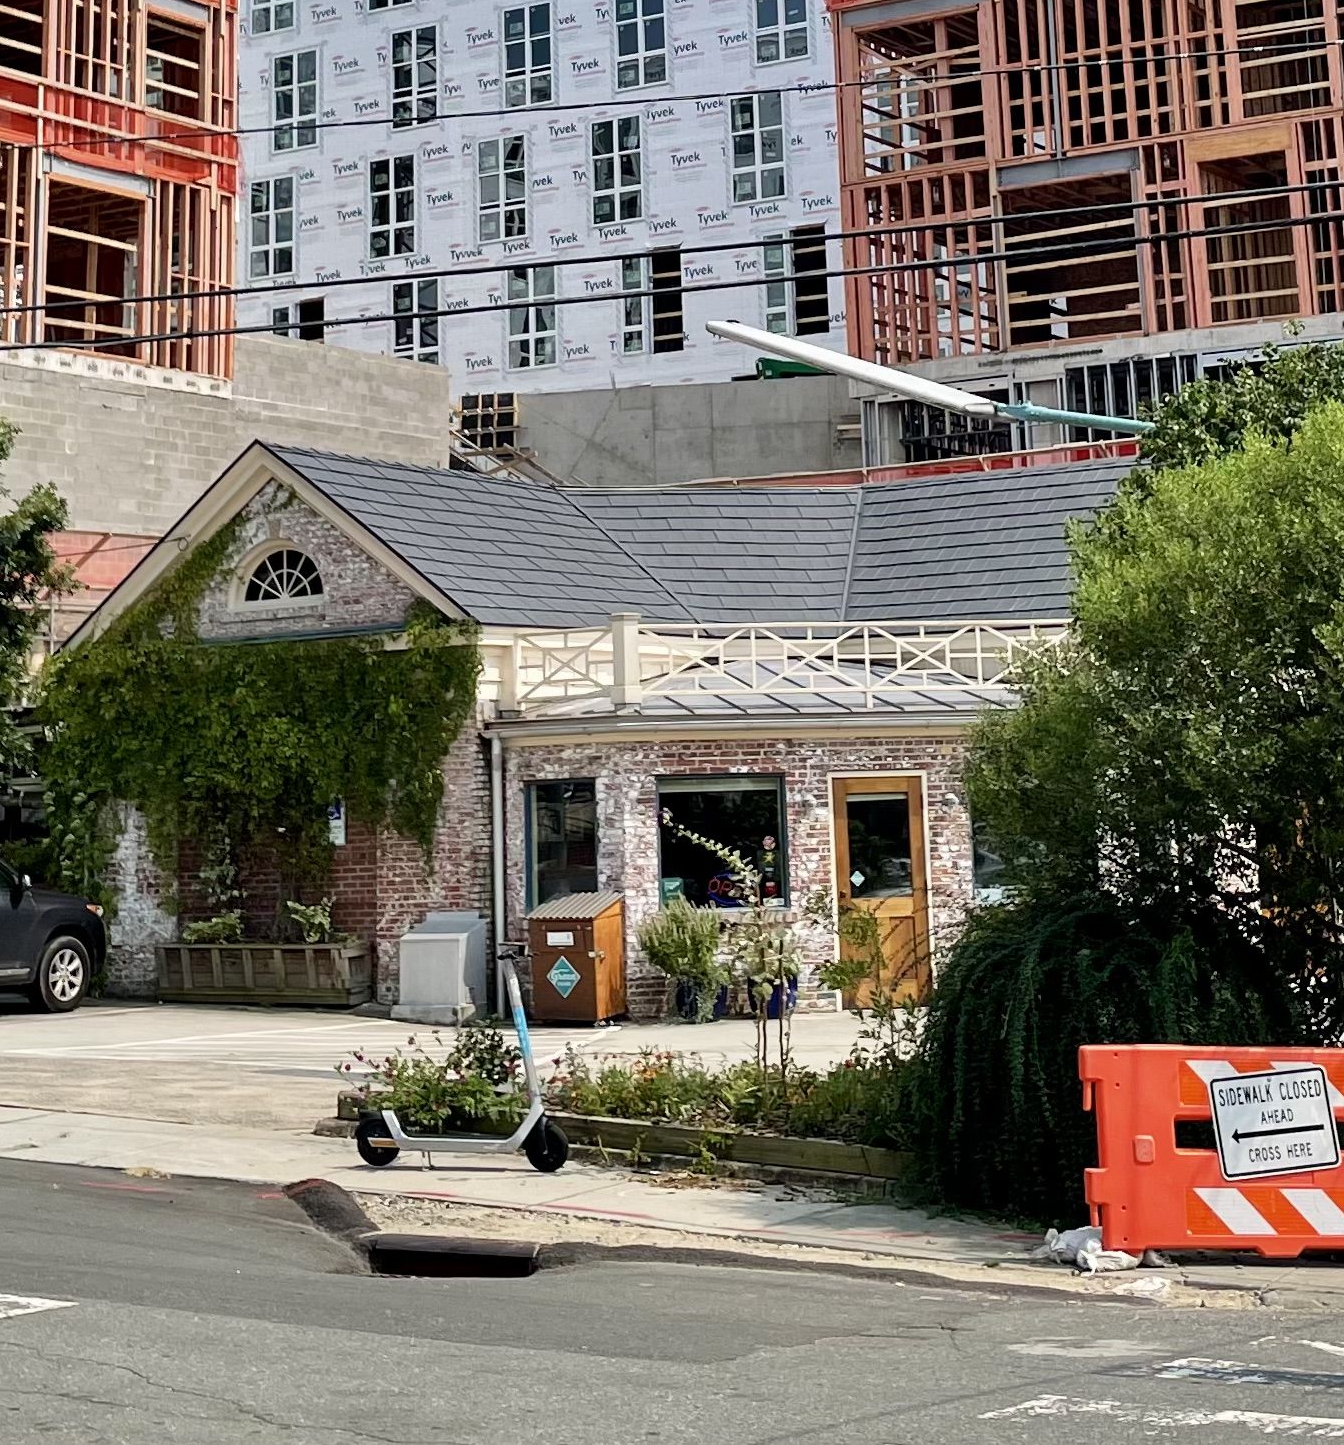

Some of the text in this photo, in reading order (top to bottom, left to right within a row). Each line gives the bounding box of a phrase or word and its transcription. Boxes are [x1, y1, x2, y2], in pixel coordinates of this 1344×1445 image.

[312, 7, 336, 20] Tyvek
[558, 15, 576, 24] vek
[466, 31, 493, 44] Tyvek
[719, 32, 747, 45] Tyvek
[674, 41, 697, 54] yvek
[334, 59, 359, 71] Tyvek
[572, 58, 599, 72] Tyvek
[478, 77, 499, 89] Tyve
[354, 99, 379, 112] Tyvek
[696, 99, 724, 112] Tyvek
[549, 124, 576, 136] Tyvek
[671, 152, 700, 165] Tyvek
[333, 161, 358, 174] Tyvek
[427, 191, 453, 205] Tyvek
[801, 196, 832, 210] Tyvek
[337, 206, 362, 220] Tyvek
[749, 203, 779, 216] Tyvek
[698, 211, 728, 224] Tyvek
[599, 226, 626, 238] Tyvek
[550, 233, 578, 245] Tyvek
[502, 241, 530, 253] Tyvek
[405, 256, 431, 268] Tyvek
[735, 260, 757, 272] Tyve
[316, 270, 341, 282] Tyvek
[684, 264, 713, 278] Tyvek
[584, 279, 612, 292] Tyvek
[466, 357, 493, 369] Tyvek
[1218, 1079, 1322, 1106] SIDEWALK CLOSED
[1261, 1108, 1294, 1125] AHEAD
[1249, 1142, 1313, 1163] CROSS HERE
